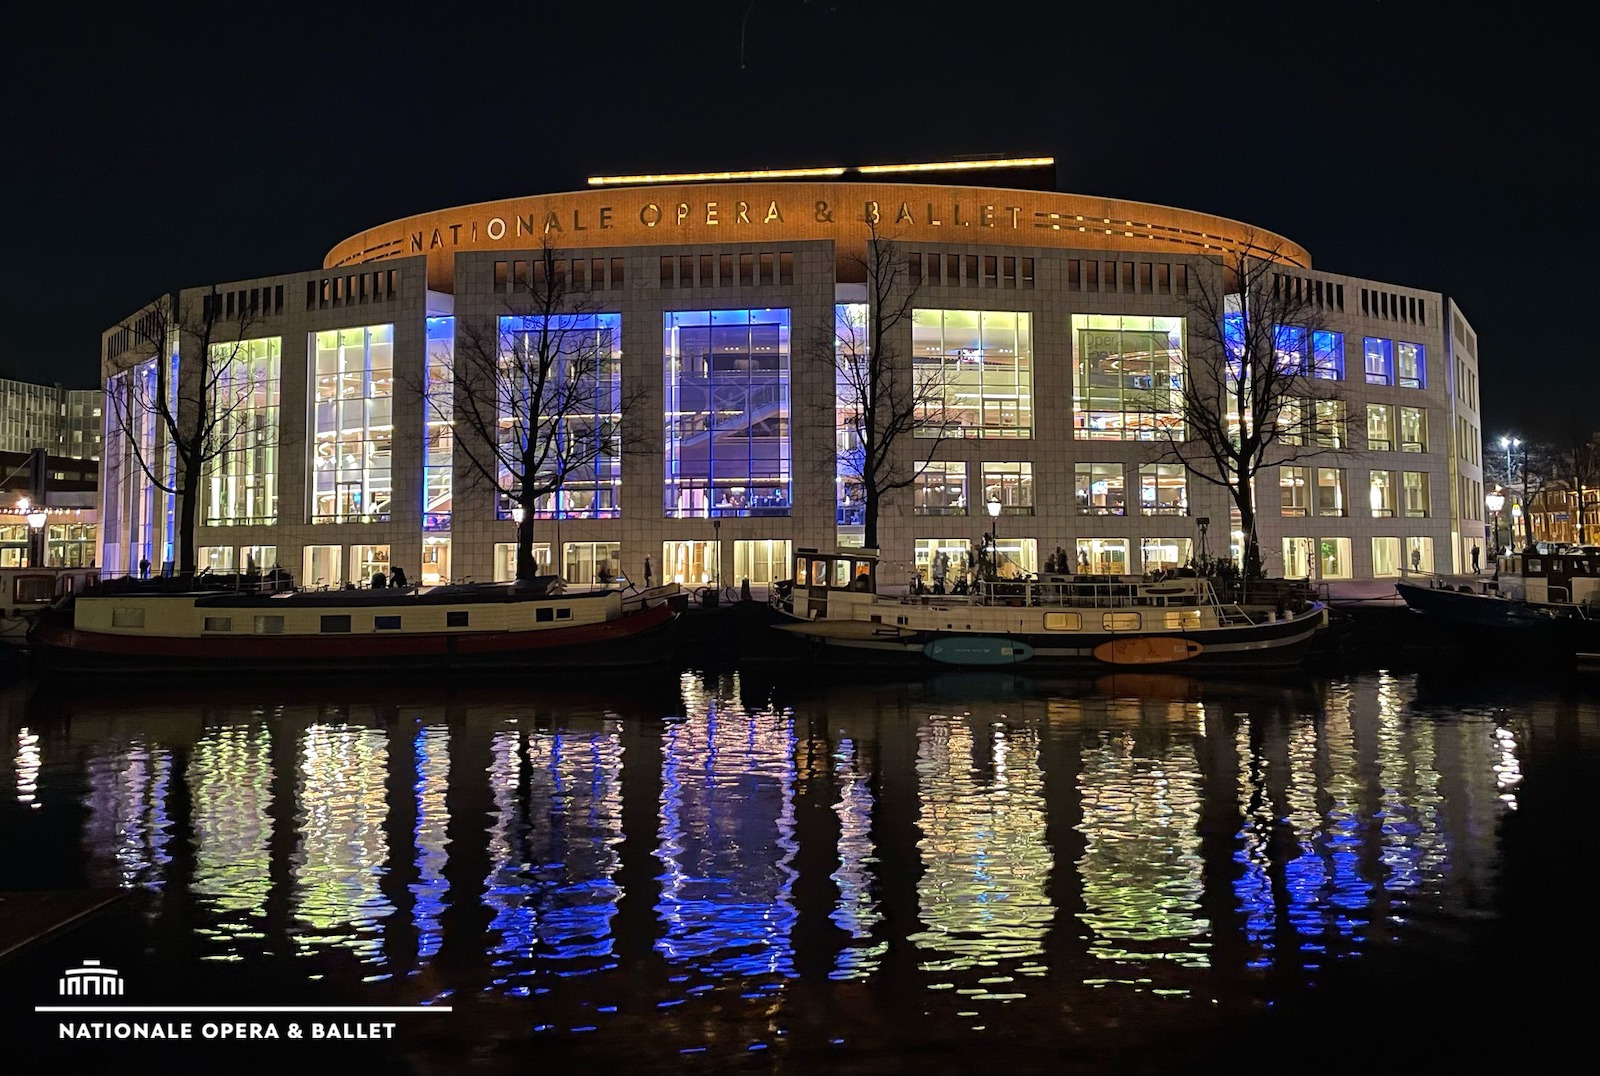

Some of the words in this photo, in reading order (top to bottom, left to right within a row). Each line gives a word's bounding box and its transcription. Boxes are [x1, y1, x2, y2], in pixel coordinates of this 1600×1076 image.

[409, 206, 612, 252] NATIONALE
[640, 201, 784, 228] OPERA
[814, 200, 835, 223] &
[866, 201, 1023, 229] BALLET
